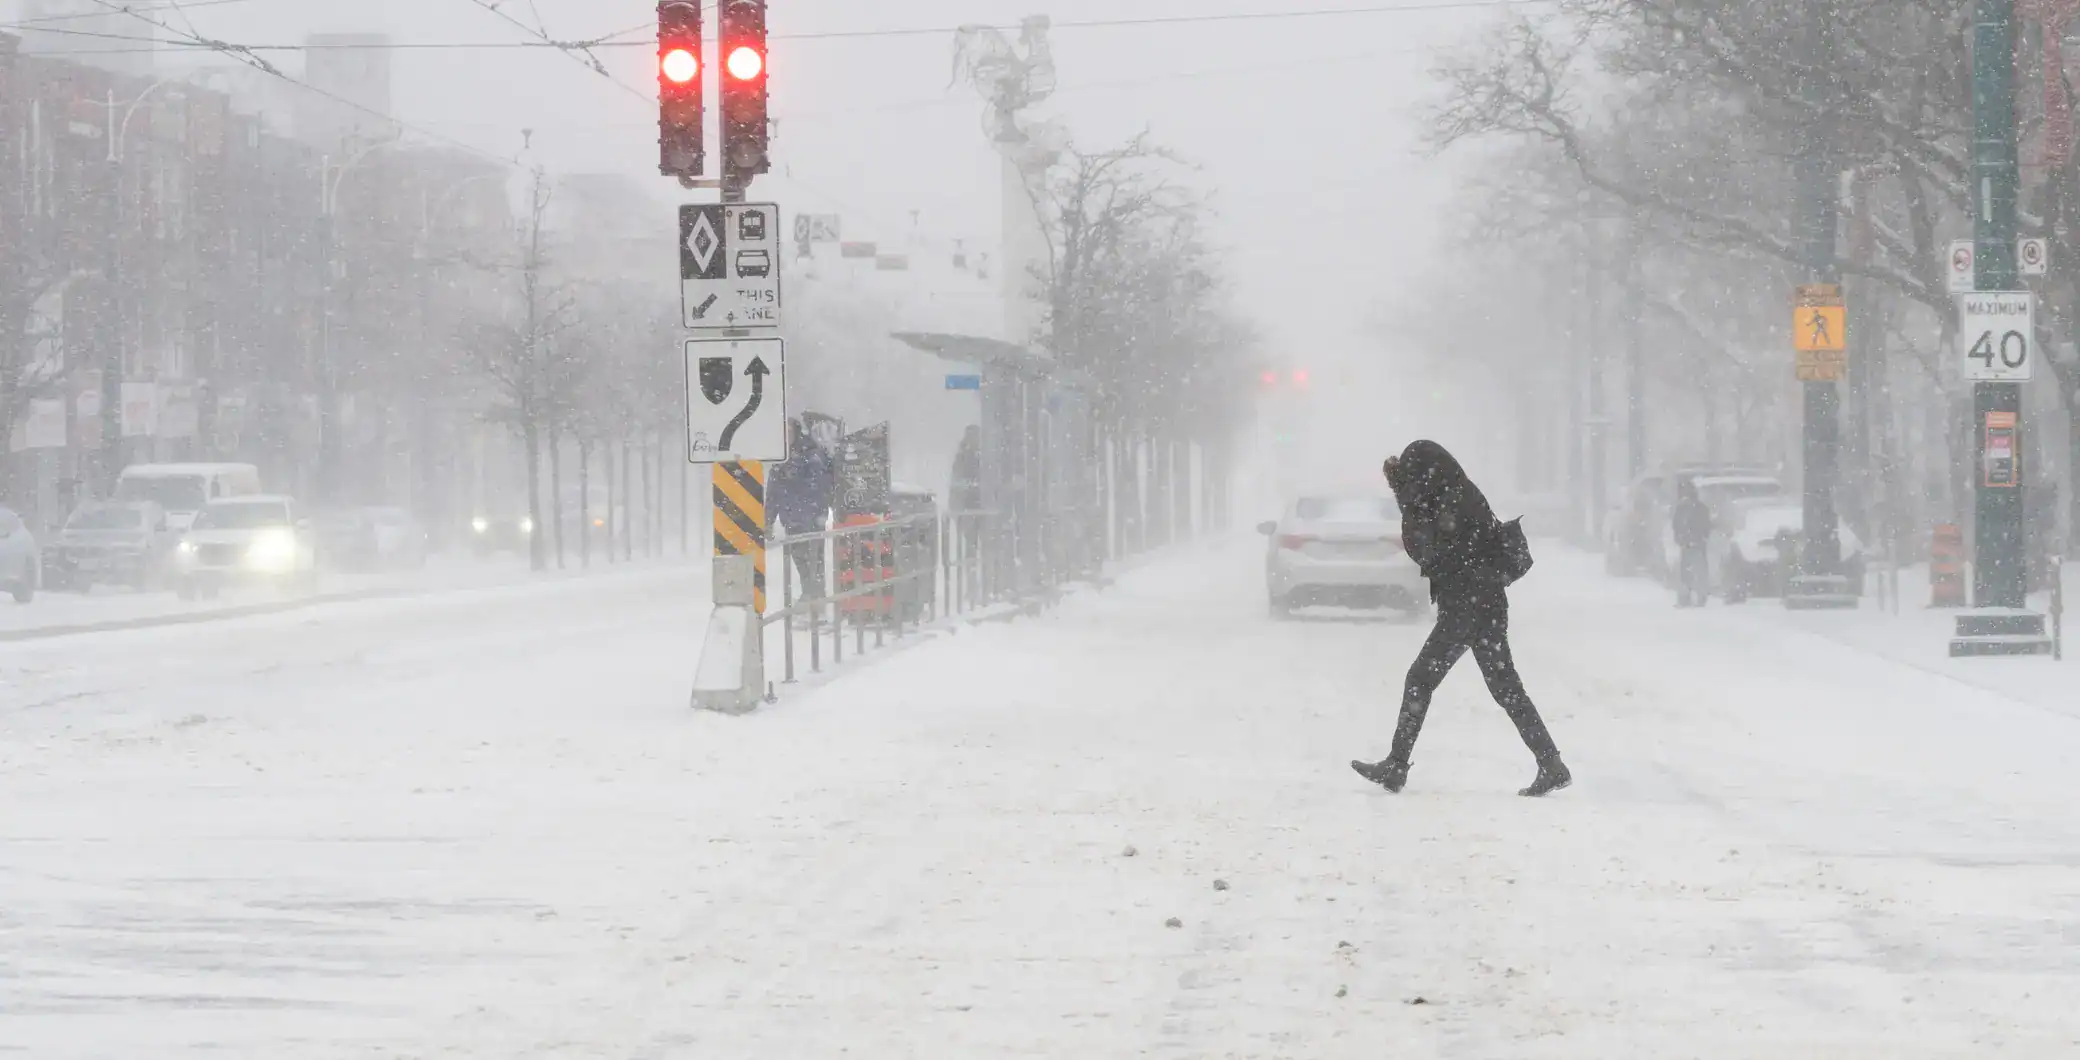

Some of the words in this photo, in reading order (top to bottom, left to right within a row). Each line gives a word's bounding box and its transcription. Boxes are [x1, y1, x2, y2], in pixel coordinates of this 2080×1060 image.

[736, 289, 774, 302] THIS
[1967, 301, 2027, 315] MAXIMUM
[1968, 329, 2027, 369] 40
